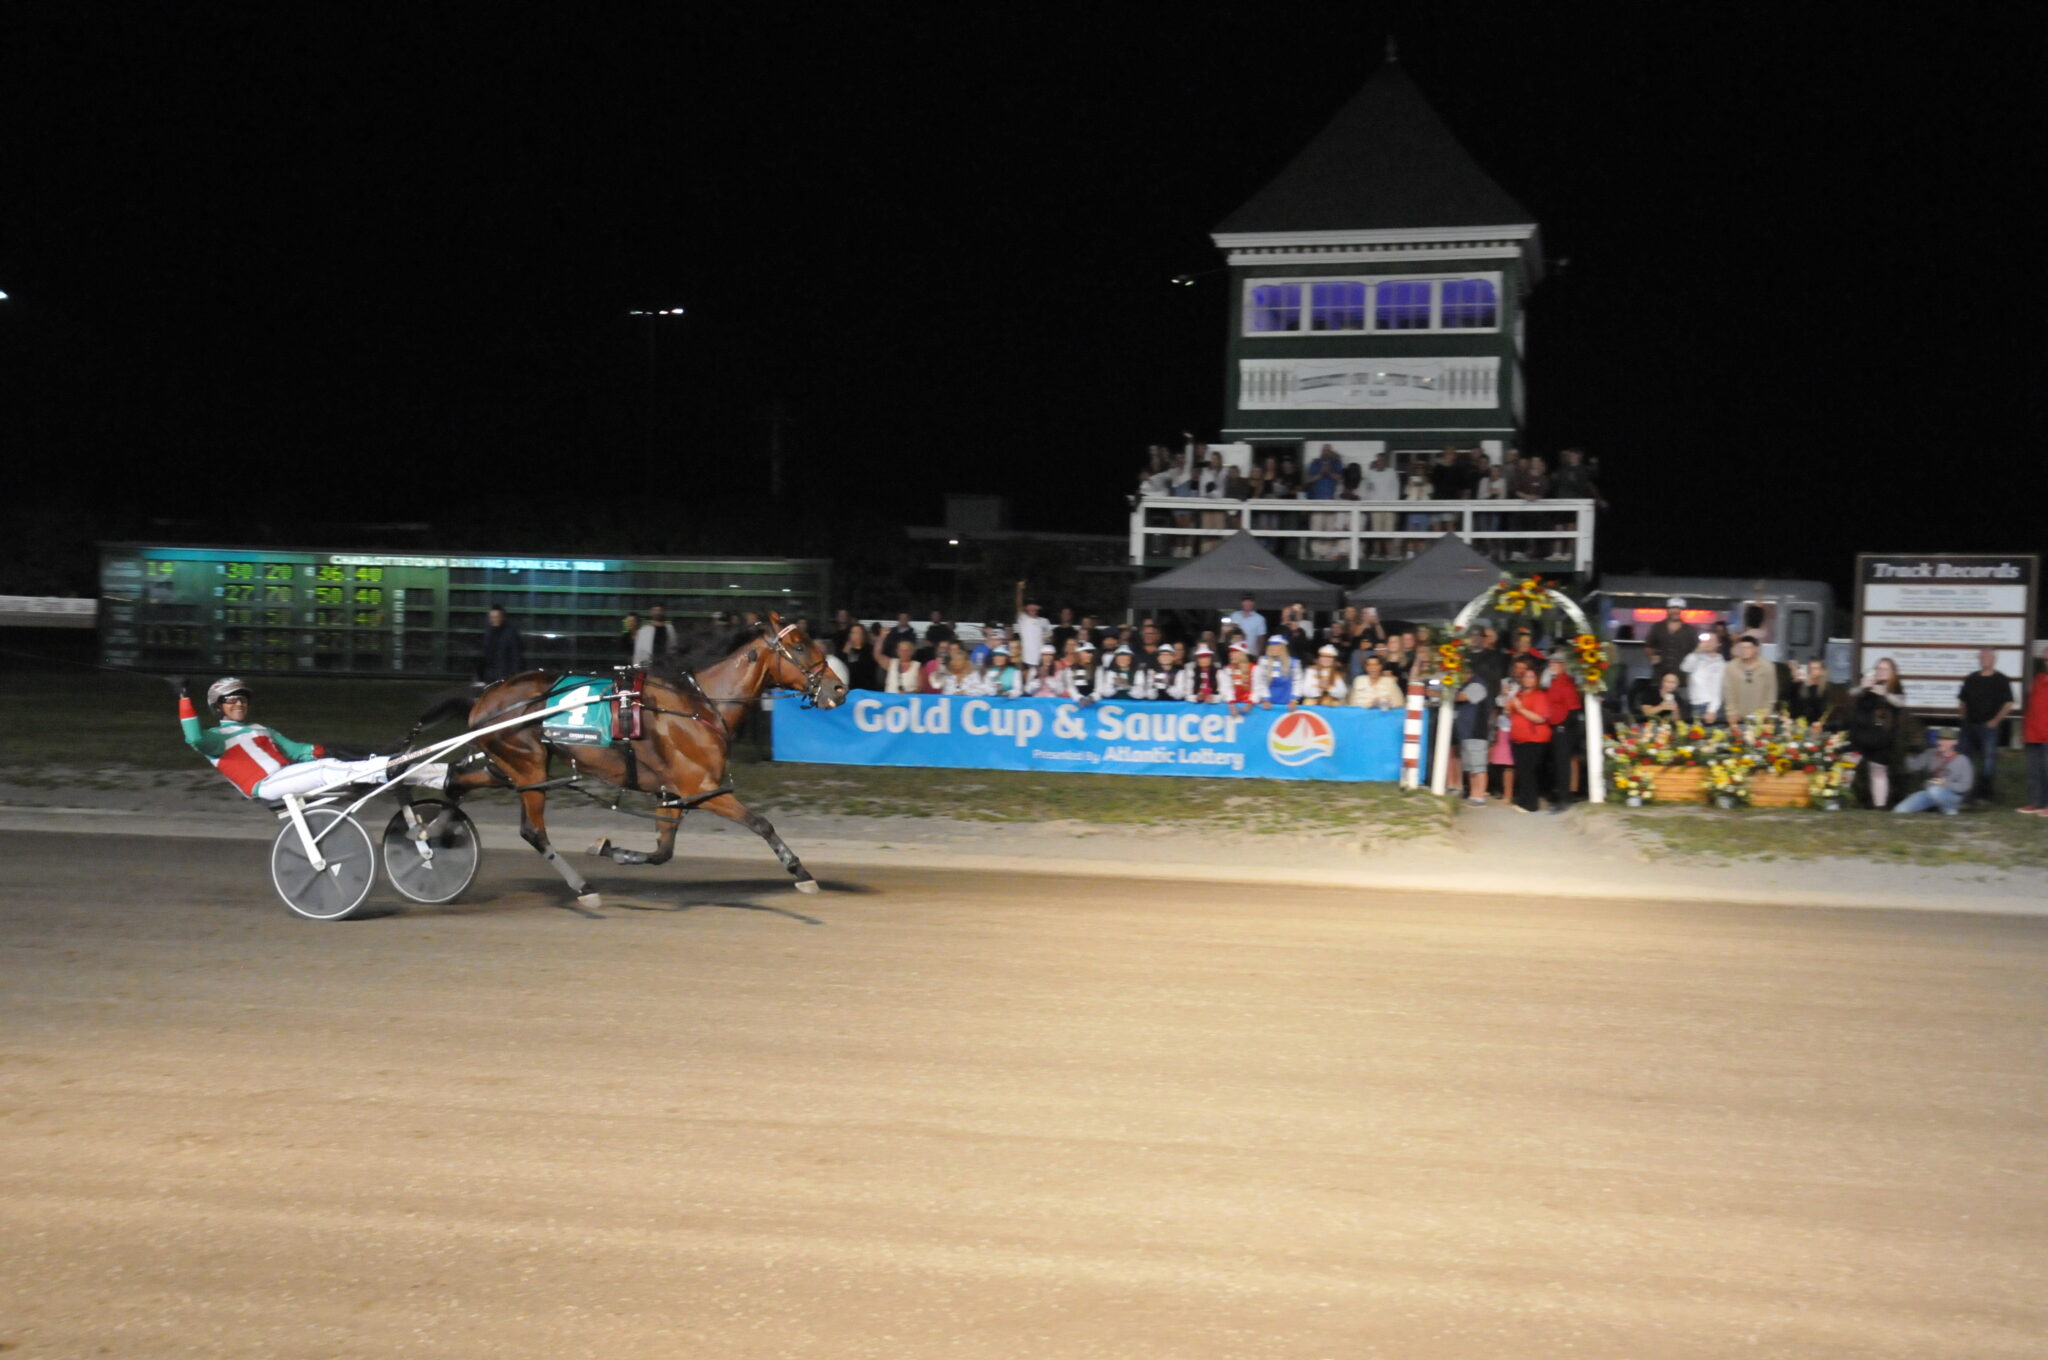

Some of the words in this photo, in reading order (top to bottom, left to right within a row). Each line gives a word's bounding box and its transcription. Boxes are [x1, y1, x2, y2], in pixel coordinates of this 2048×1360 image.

[449, 558, 505, 568] DRIVING
[506, 560, 541, 569] PARK
[853, 697, 950, 734] Gold
[961, 700, 1042, 747] Cup
[1052, 704, 1088, 740] &
[1096, 705, 1244, 743] Saucer
[1103, 746, 1177, 763] Atlantic
[1179, 748, 1245, 771] Lottery
